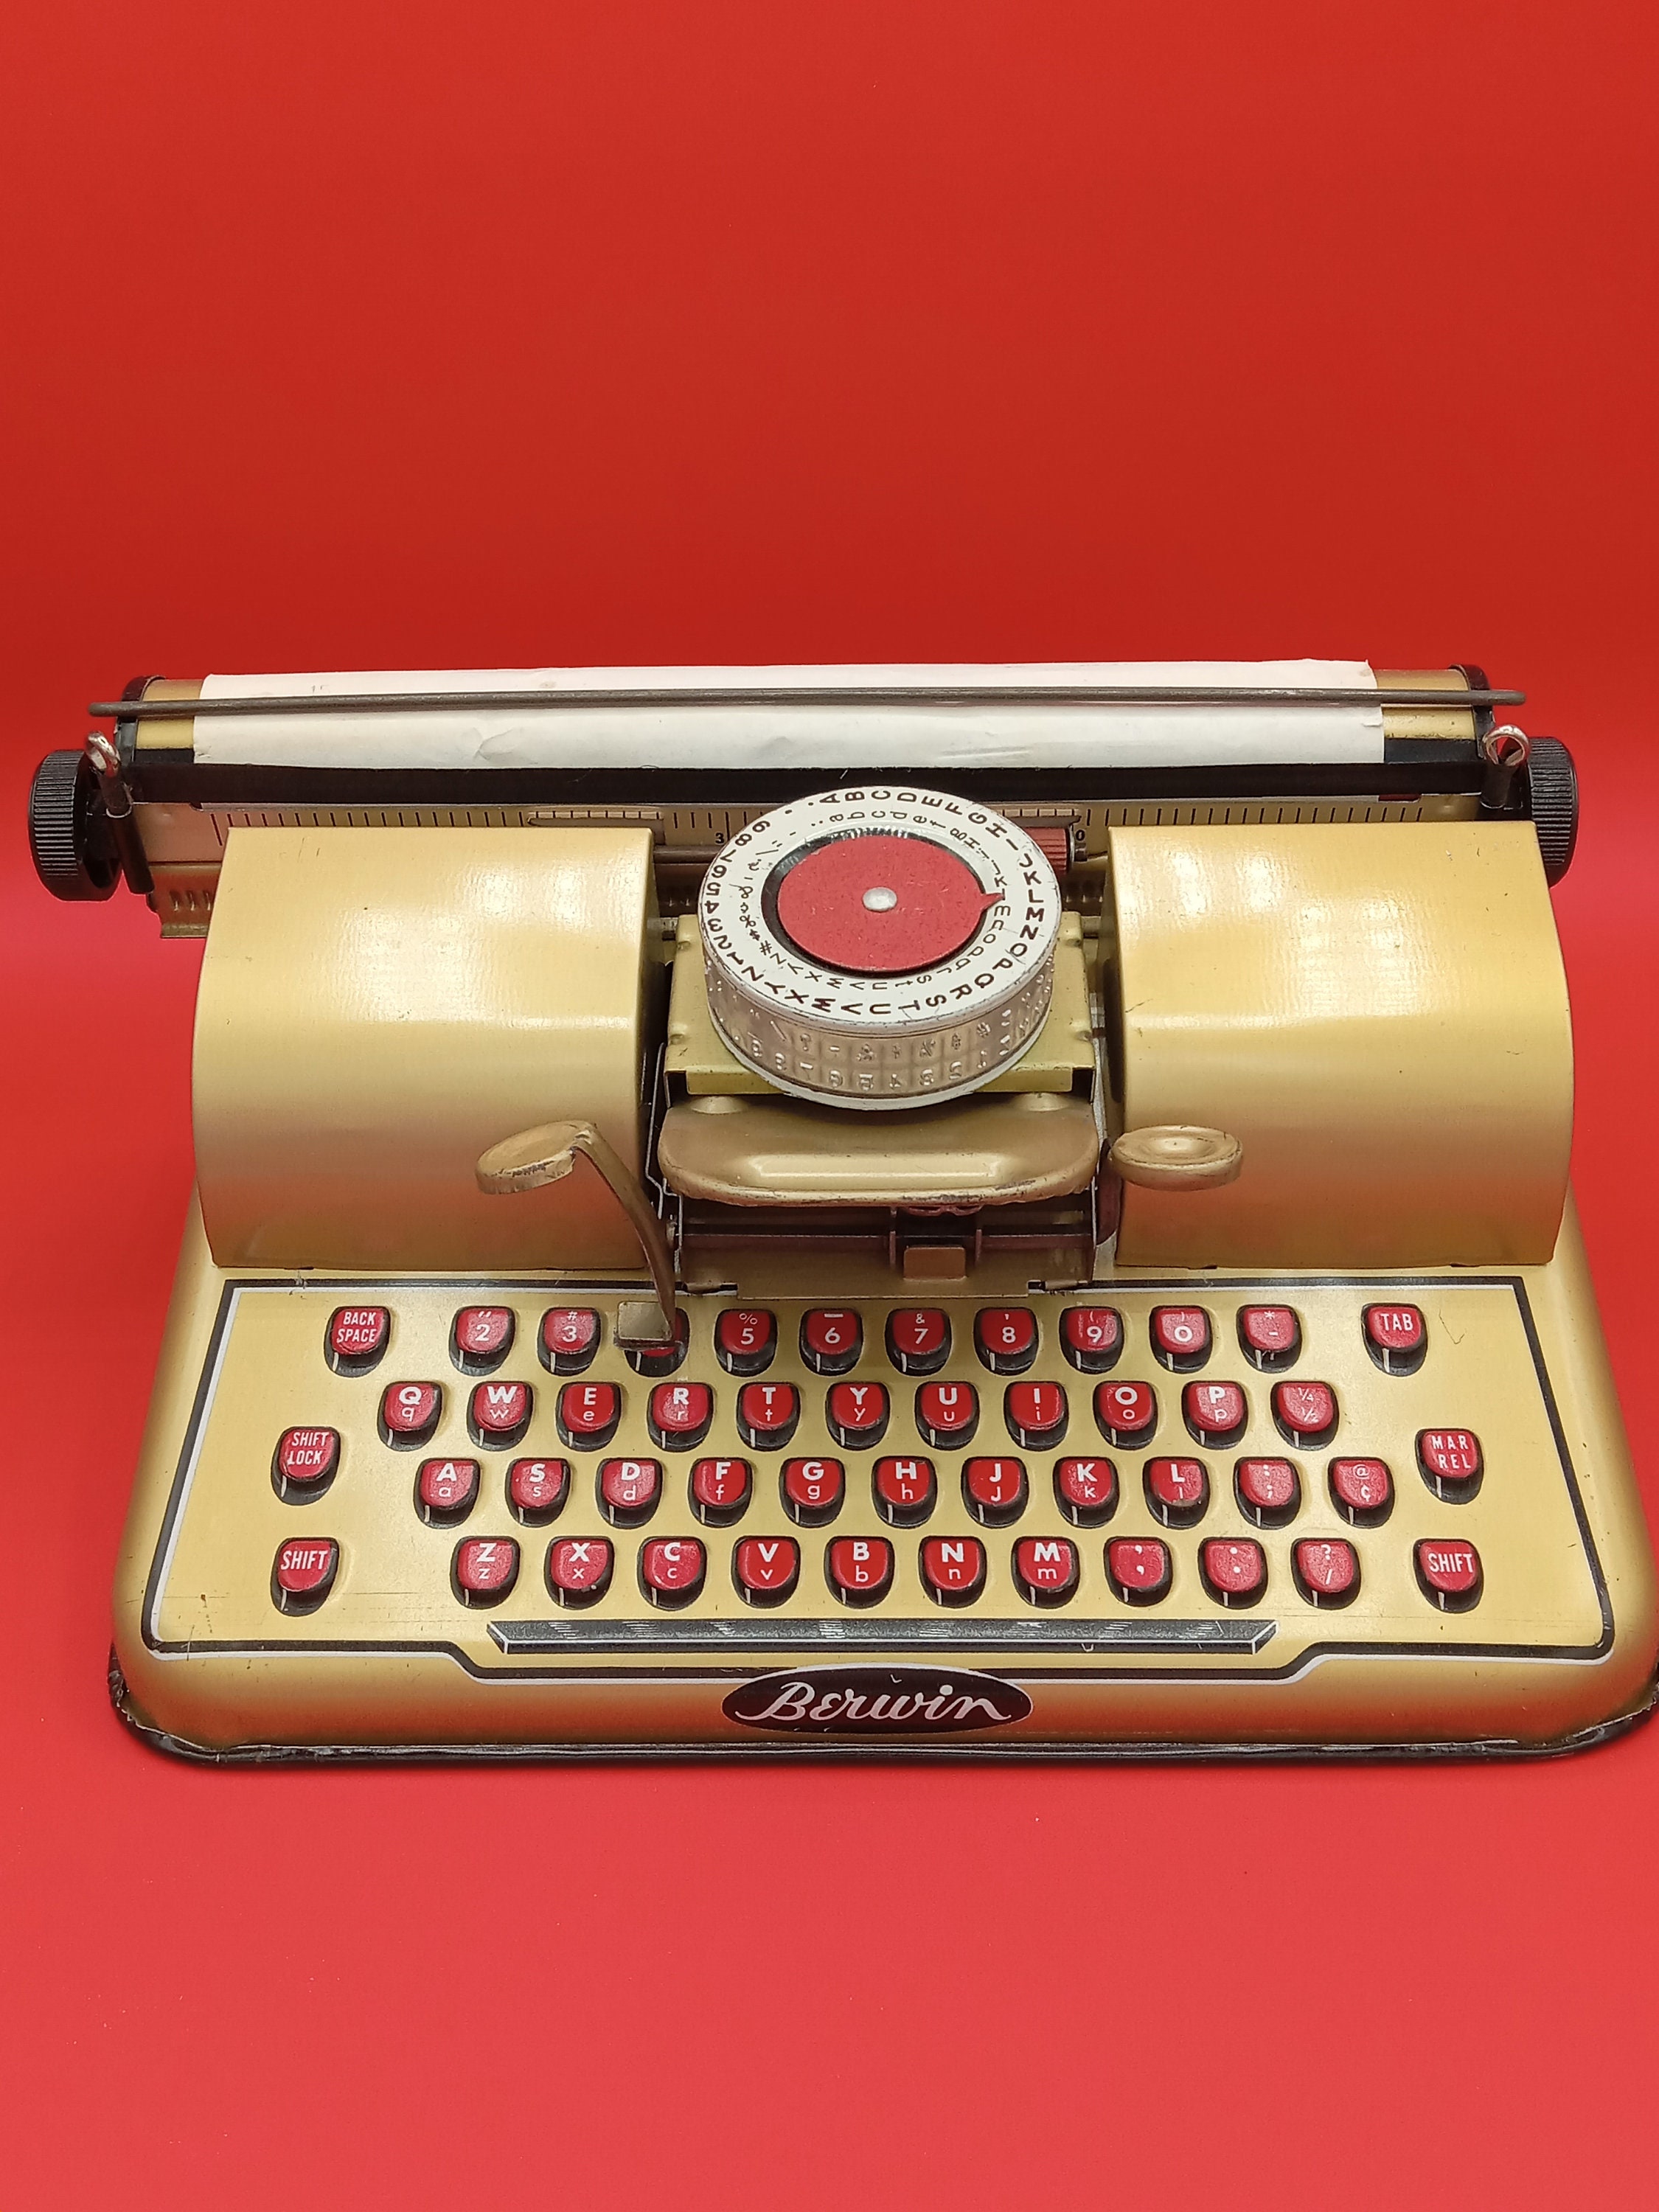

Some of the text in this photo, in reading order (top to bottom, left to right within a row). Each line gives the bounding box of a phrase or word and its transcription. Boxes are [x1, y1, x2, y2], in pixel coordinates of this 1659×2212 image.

[820, 793, 840, 803] A
[845, 792, 864, 801] B
[872, 791, 891, 799] C
[897, 793, 917, 801] D
[922, 796, 942, 807] E
[945, 802, 962, 815] F
[968, 813, 987, 824] G
[753, 821, 770, 832] 9
[986, 823, 1007, 838] H
[735, 834, 751, 846] 8
[1006, 839, 1018, 850] I
[720, 849, 736, 862] 7
[1020, 854, 1032, 867] J
[712, 865, 726, 878] 6
[1023, 871, 1041, 885] K
[706, 883, 720, 895] 5
[1029, 889, 1043, 902] L
[705, 901, 719, 914] 4
[1026, 907, 1044, 922] M
[708, 919, 723, 932] 3
[1020, 925, 1038, 939] N
[714, 935, 731, 949] 2
[1011, 943, 1027, 957] O
[727, 952, 743, 964] 1
[992, 959, 1012, 970] P
[742, 967, 764, 981] Z
[975, 973, 994, 988] Q
[765, 982, 785, 994] Y
[950, 984, 972, 999] R
[785, 990, 809, 1004] X
[926, 995, 946, 1006] S
[812, 998, 835, 1012] W
[841, 1004, 863, 1015] V
[869, 1004, 891, 1014] U
[898, 1001, 920, 1010] T
[344, 1312, 376, 1325] BACK
[916, 1314, 925, 1324] &
[1380, 1314, 1413, 1330] TAB
[337, 1329, 379, 1343] SPACE
[476, 1324, 490, 1340] 2
[563, 1326, 577, 1342] 3
[741, 1329, 754, 1344] 5
[825, 1327, 840, 1343] 6
[915, 1329, 928, 1343] 7
[1003, 1327, 1015, 1343] 8
[1088, 1326, 1102, 1343] 9
[400, 1387, 421, 1405] Q
[488, 1386, 517, 1403] W
[584, 1388, 597, 1405] E
[673, 1388, 689, 1405] R
[762, 1387, 776, 1404] T
[850, 1388, 868, 1405] Y
[939, 1388, 957, 1405] U
[1034, 1388, 1040, 1403] I
[1116, 1387, 1137, 1405] O
[1209, 1387, 1225, 1403] P
[402, 1408, 414, 1422] q
[583, 1411, 594, 1421] e
[678, 1411, 687, 1420] r
[765, 1409, 772, 1421] t
[944, 1412, 954, 1421] u
[1214, 1409, 1227, 1422] p
[292, 1432, 329, 1446] SHIFT
[1432, 1436, 1468, 1449] MAR
[288, 1450, 322, 1465] LOCK
[1439, 1454, 1471, 1468] REL
[437, 1463, 456, 1481] A
[529, 1464, 545, 1484] S
[622, 1463, 640, 1480] D
[716, 1462, 731, 1480] F
[803, 1462, 824, 1480] G
[896, 1462, 917, 1479] H
[990, 1464, 1001, 1482] J
[1077, 1464, 1097, 1481] K
[1171, 1464, 1185, 1482] L
[1353, 1464, 1369, 1479] @
[439, 1487, 451, 1497] a
[533, 1486, 541, 1497] s
[624, 1485, 636, 1500] d
[716, 1484, 724, 1500] f
[808, 1486, 819, 1499] g
[902, 1484, 913, 1499] h
[476, 1543, 496, 1562] Z
[569, 1543, 590, 1562] X
[664, 1543, 681, 1561] C
[758, 1543, 779, 1562] V
[854, 1543, 869, 1560] B
[942, 1543, 964, 1562] N
[1034, 1543, 1061, 1561] M
[1321, 1545, 1331, 1559] ?
[281, 1551, 327, 1569] SHIFT
[1428, 1554, 1472, 1572] SHIFT
[667, 1568, 676, 1579] c
[856, 1565, 868, 1582] b
[949, 1569, 960, 1579] n
[1038, 1569, 1057, 1579] m
[735, 1682, 1011, 1720] Berwin
